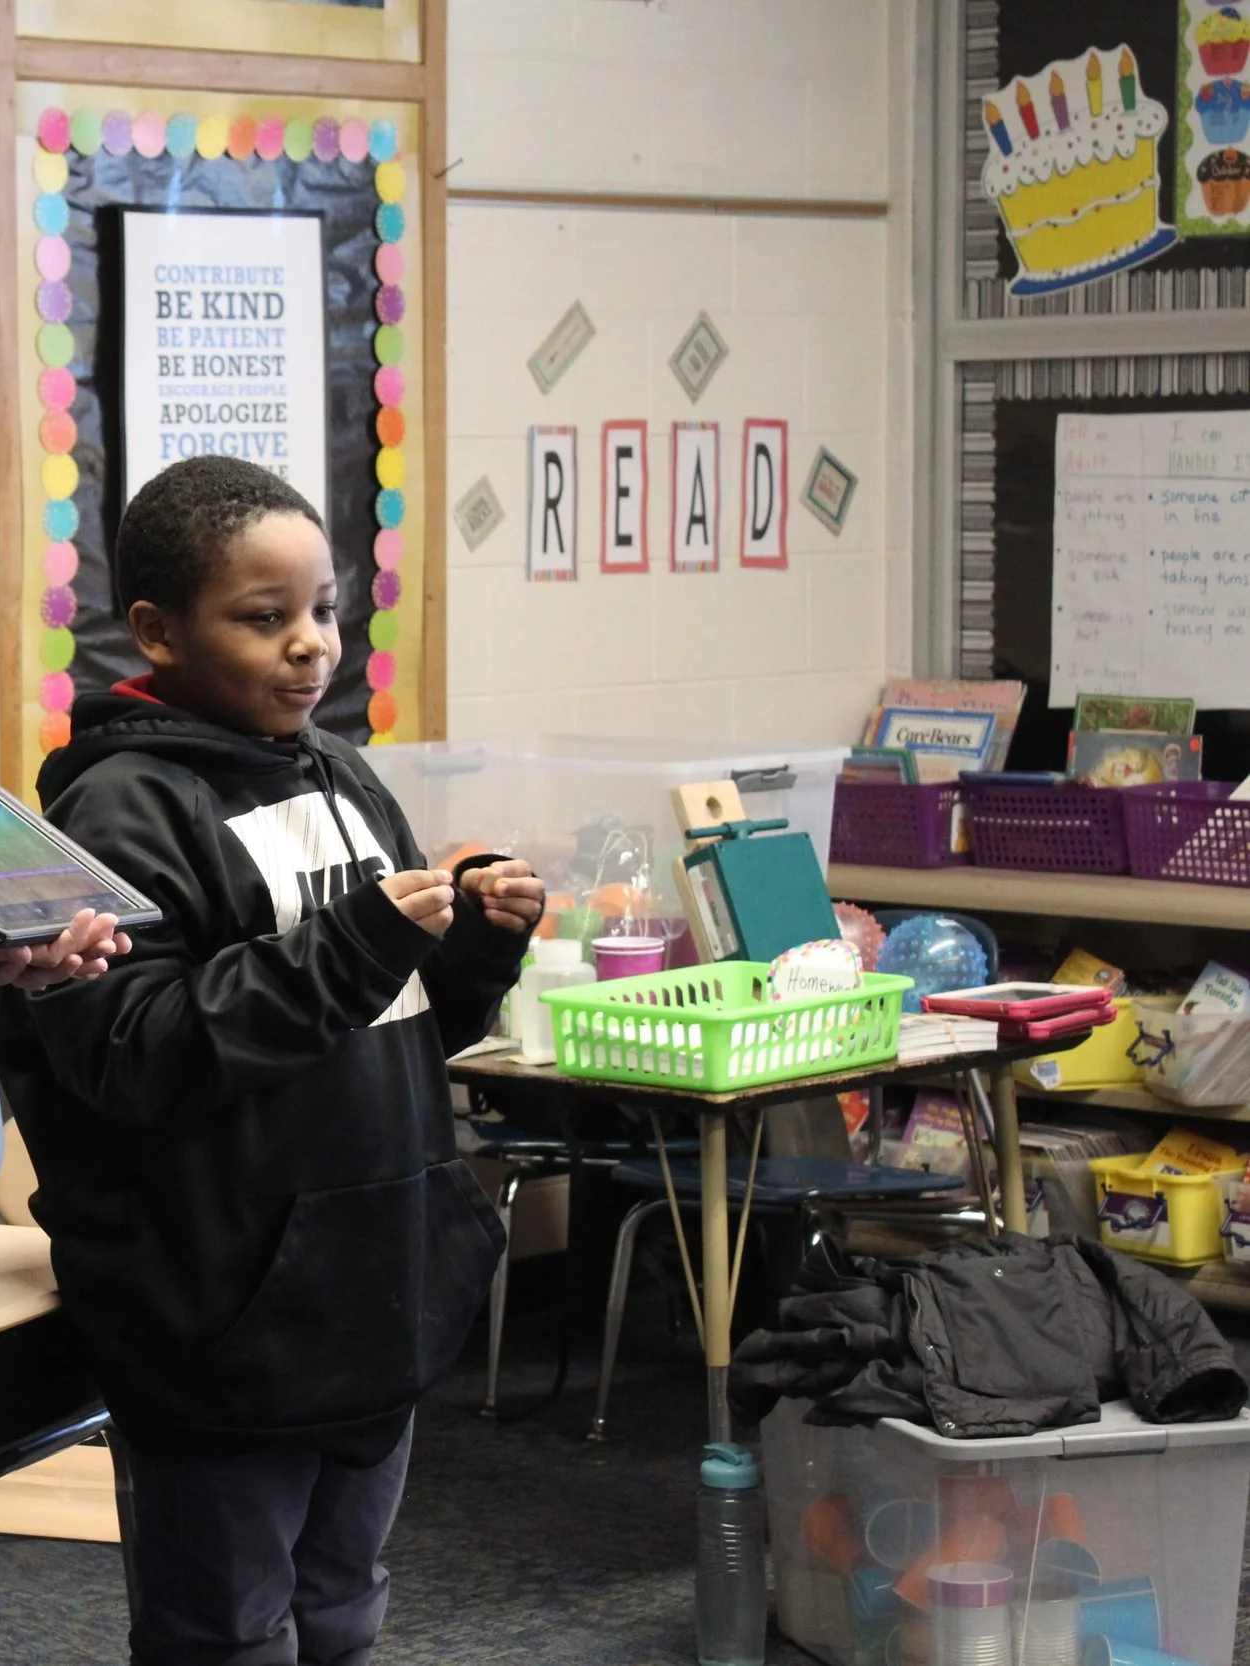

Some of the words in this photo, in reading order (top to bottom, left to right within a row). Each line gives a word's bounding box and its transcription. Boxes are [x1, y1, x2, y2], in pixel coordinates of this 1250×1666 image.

[154, 264, 285, 285] CONTRIBUTE
[155, 290, 192, 319] BE
[201, 291, 285, 320] KIND
[156, 326, 183, 348] BE
[188, 326, 286, 348] PATIENT
[157, 355, 185, 377] BE
[192, 355, 286, 377] HONEST
[158, 384, 235, 397] ENCOURAGE
[238, 384, 287, 397] PEOPLE
[159, 403, 287, 424] APOLOGIZE
[160, 432, 288, 460] FORGIVE
